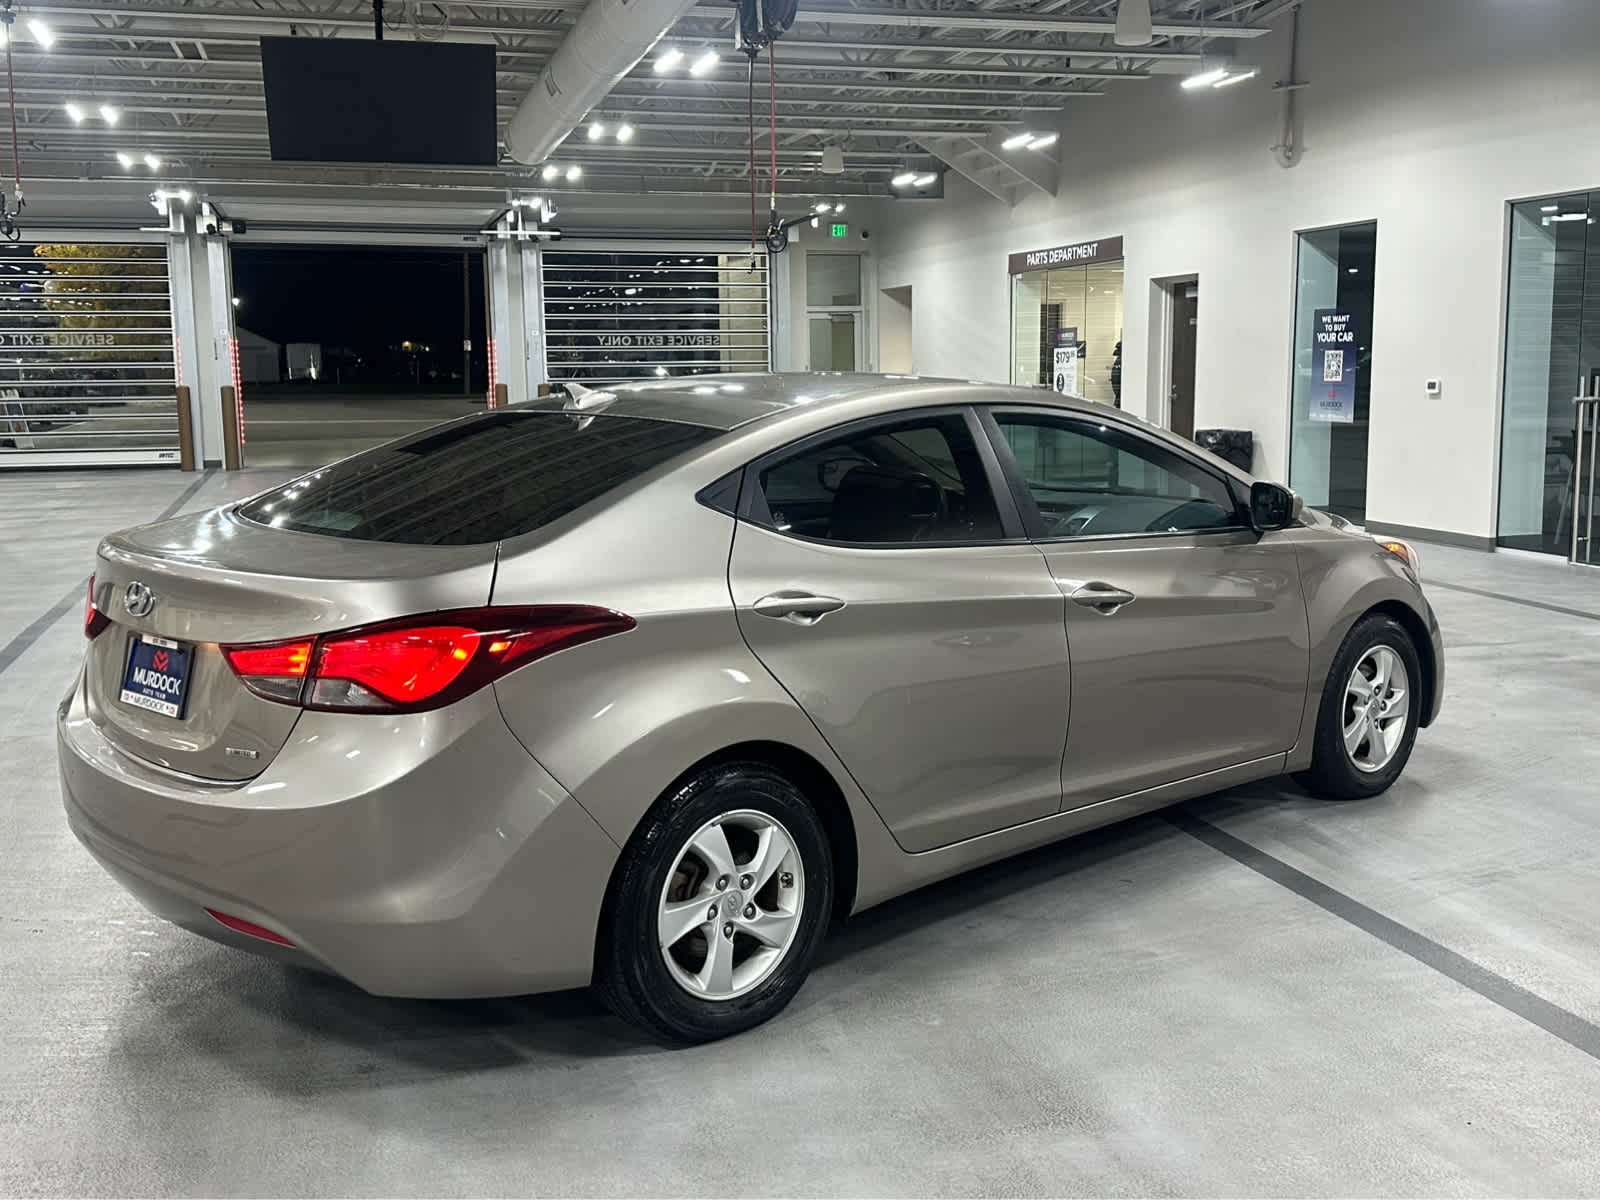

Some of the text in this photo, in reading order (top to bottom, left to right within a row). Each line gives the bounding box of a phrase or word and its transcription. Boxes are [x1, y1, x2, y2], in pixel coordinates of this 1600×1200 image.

[832, 224, 847, 238] EXIT
[1026, 243, 1098, 266] PARTS DEPARTMENT
[1321, 314, 1350, 323] WE WANT
[1325, 323, 1346, 332] TO BUY
[1316, 331, 1354, 343] YOUR CAR
[132, 667, 182, 695] MURDOCK
